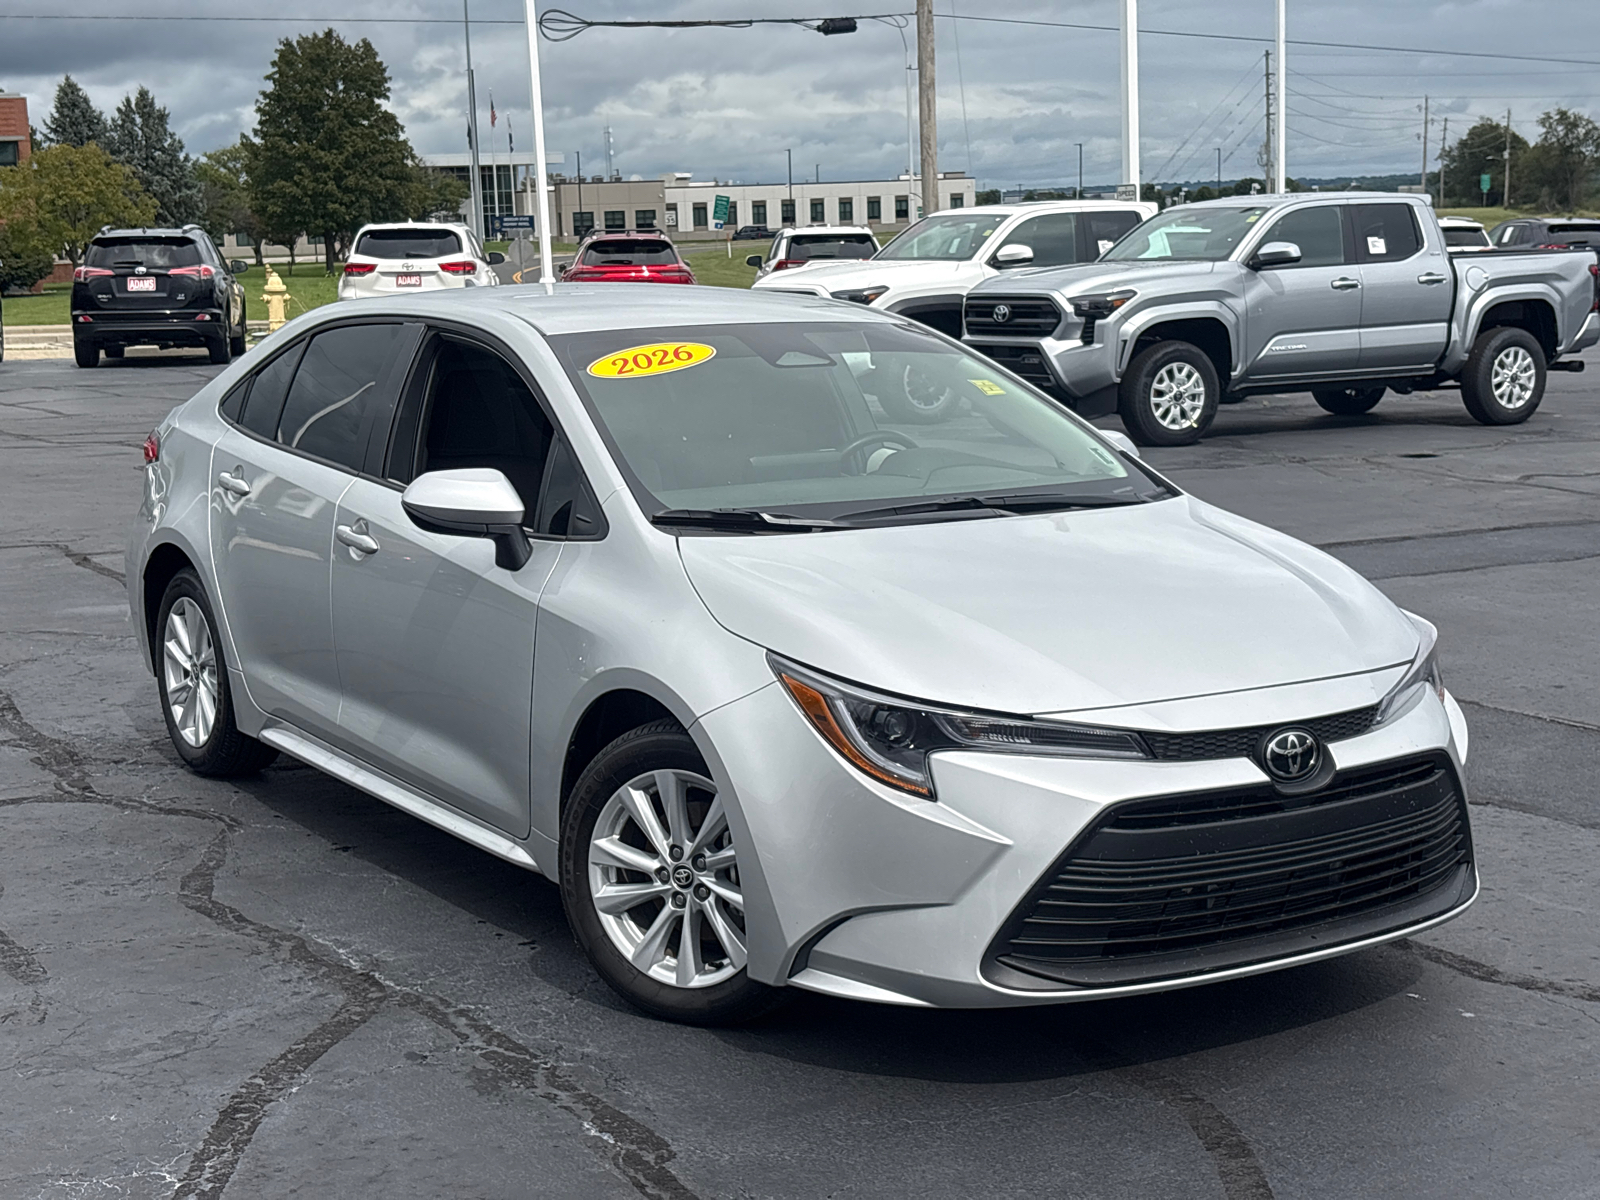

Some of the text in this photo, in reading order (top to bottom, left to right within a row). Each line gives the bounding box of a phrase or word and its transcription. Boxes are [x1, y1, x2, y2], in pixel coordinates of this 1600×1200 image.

[129, 279, 155, 289] ADAMS
[397, 275, 421, 285] ADAMS
[611, 345, 694, 375] 2026
